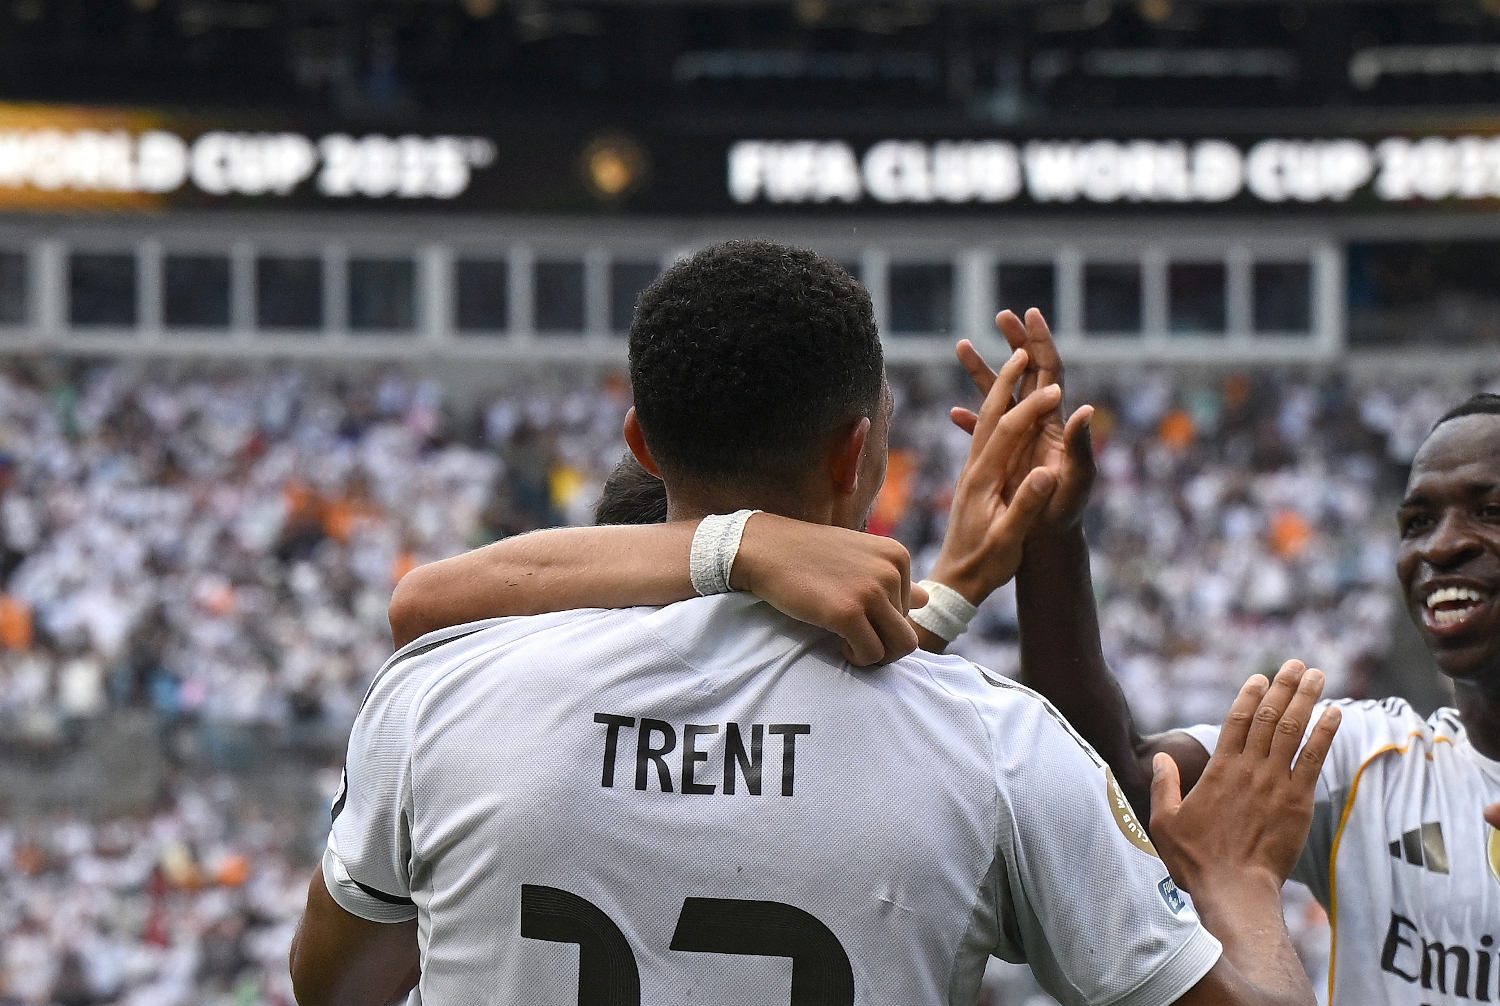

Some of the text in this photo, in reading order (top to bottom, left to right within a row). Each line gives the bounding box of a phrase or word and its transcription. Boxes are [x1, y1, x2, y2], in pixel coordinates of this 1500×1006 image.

[190, 131, 317, 194] CUP
[728, 138, 860, 202] FIFA
[863, 138, 1021, 202] CLUB
[1023, 138, 1243, 201] WORLD
[1246, 137, 1375, 200] CUP
[594, 713, 811, 797] TRENT
[1122, 813, 1149, 843] CLUB
